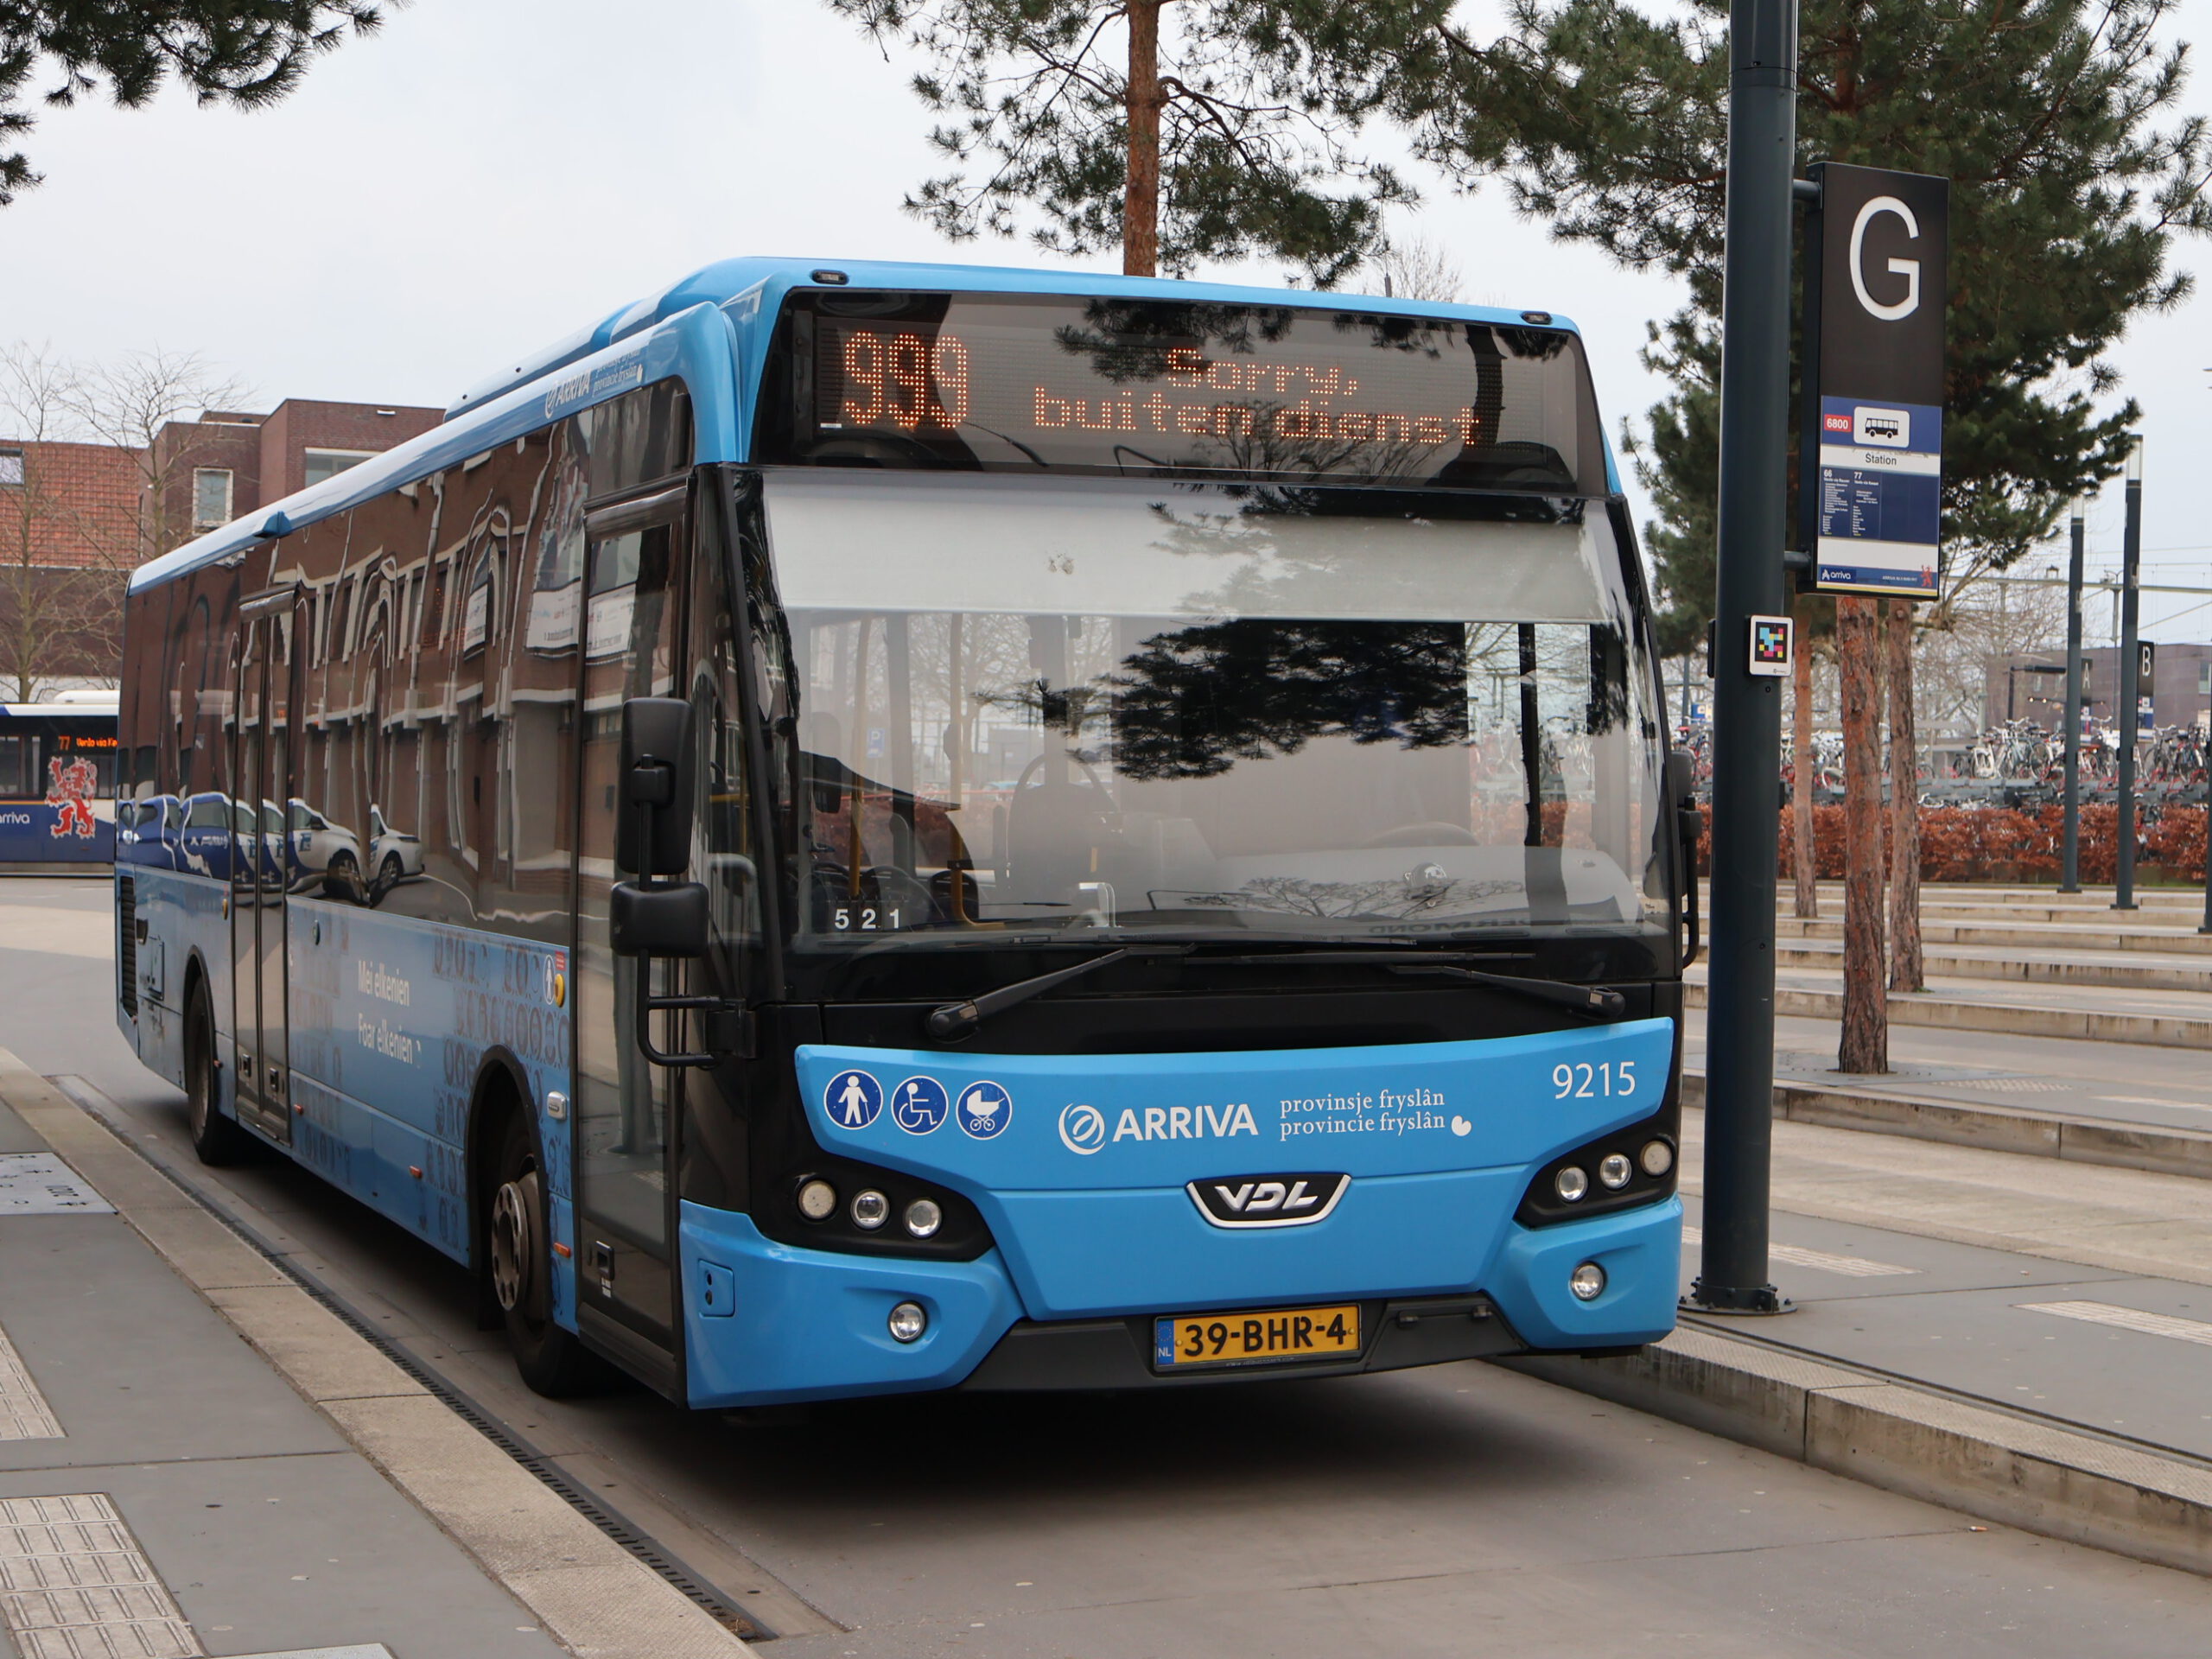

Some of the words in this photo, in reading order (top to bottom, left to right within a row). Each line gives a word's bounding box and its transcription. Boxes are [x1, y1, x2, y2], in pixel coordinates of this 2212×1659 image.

[1849, 195, 1921, 321] G
[556, 369, 591, 407] ARRIVA
[845, 331, 967, 429] 999
[1167, 348, 1357, 396] Sorry,
[1035, 387, 1251, 435] buiten
[1275, 400, 1480, 445] dienst
[1827, 417, 1848, 429] 6800
[1854, 471, 1862, 480] 77
[1866, 454, 1897, 465] Station
[1830, 570, 1851, 580] arriva
[2082, 663, 2091, 690] A
[2142, 645, 2152, 677] B
[58, 735, 71, 751] 77
[374, 963, 410, 1007] elkenien
[358, 1012, 375, 1050] Foar
[377, 1019, 413, 1065] elkenien
[1553, 1061, 1636, 1100] 9215
[1280, 1092, 1373, 1119] provinsje
[1379, 1088, 1446, 1116] fryslân
[1112, 1103, 1259, 1142] ARRIVA
[1280, 1116, 1375, 1141] provincie
[1379, 1111, 1446, 1139] fryslân
[1214, 1181, 1319, 1212] VDL
[1185, 1313, 1346, 1357] 39-BHR-4
[1158, 1347, 1172, 1357] NL
